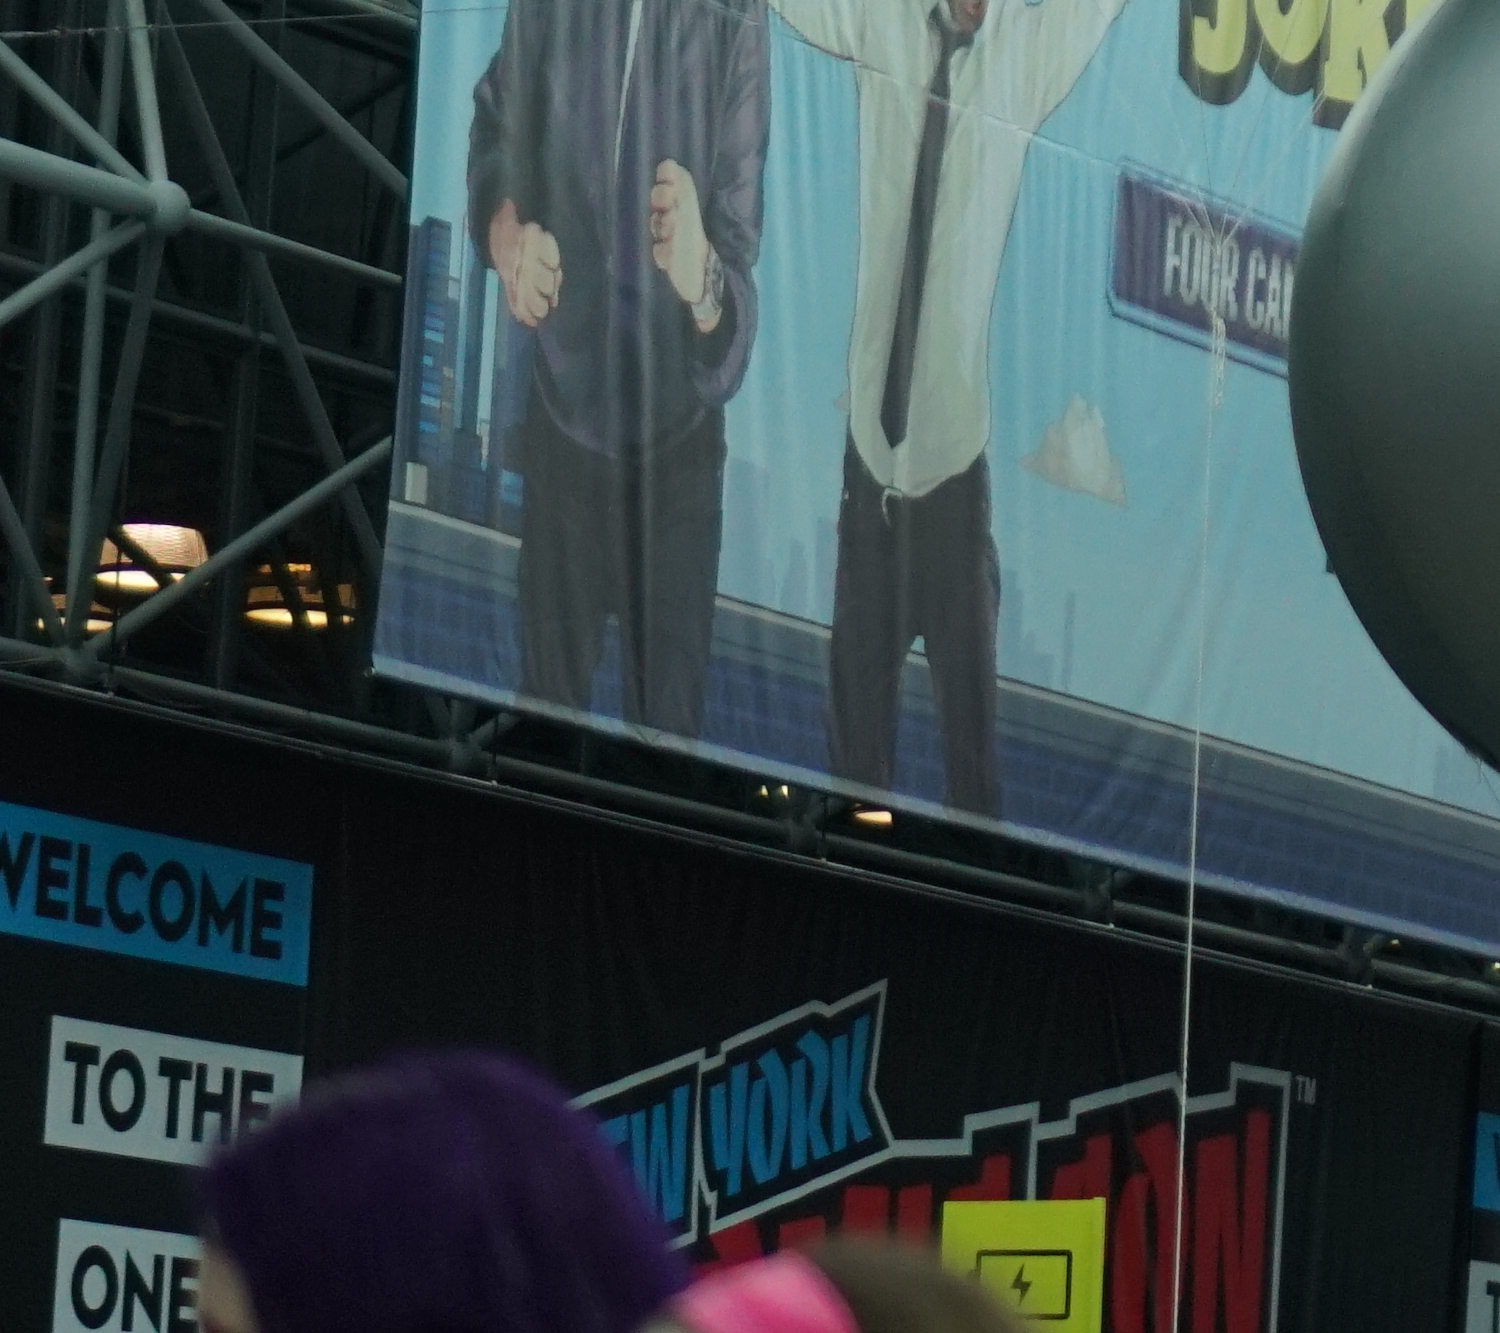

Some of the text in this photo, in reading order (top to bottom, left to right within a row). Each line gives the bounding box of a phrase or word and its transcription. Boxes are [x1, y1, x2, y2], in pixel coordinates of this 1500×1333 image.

[1163, 217, 1240, 322] FOUR
[63, 1041, 276, 1144] TO THE
[707, 1012, 874, 1198] YORK
[70, 1244, 200, 1333] ONE
